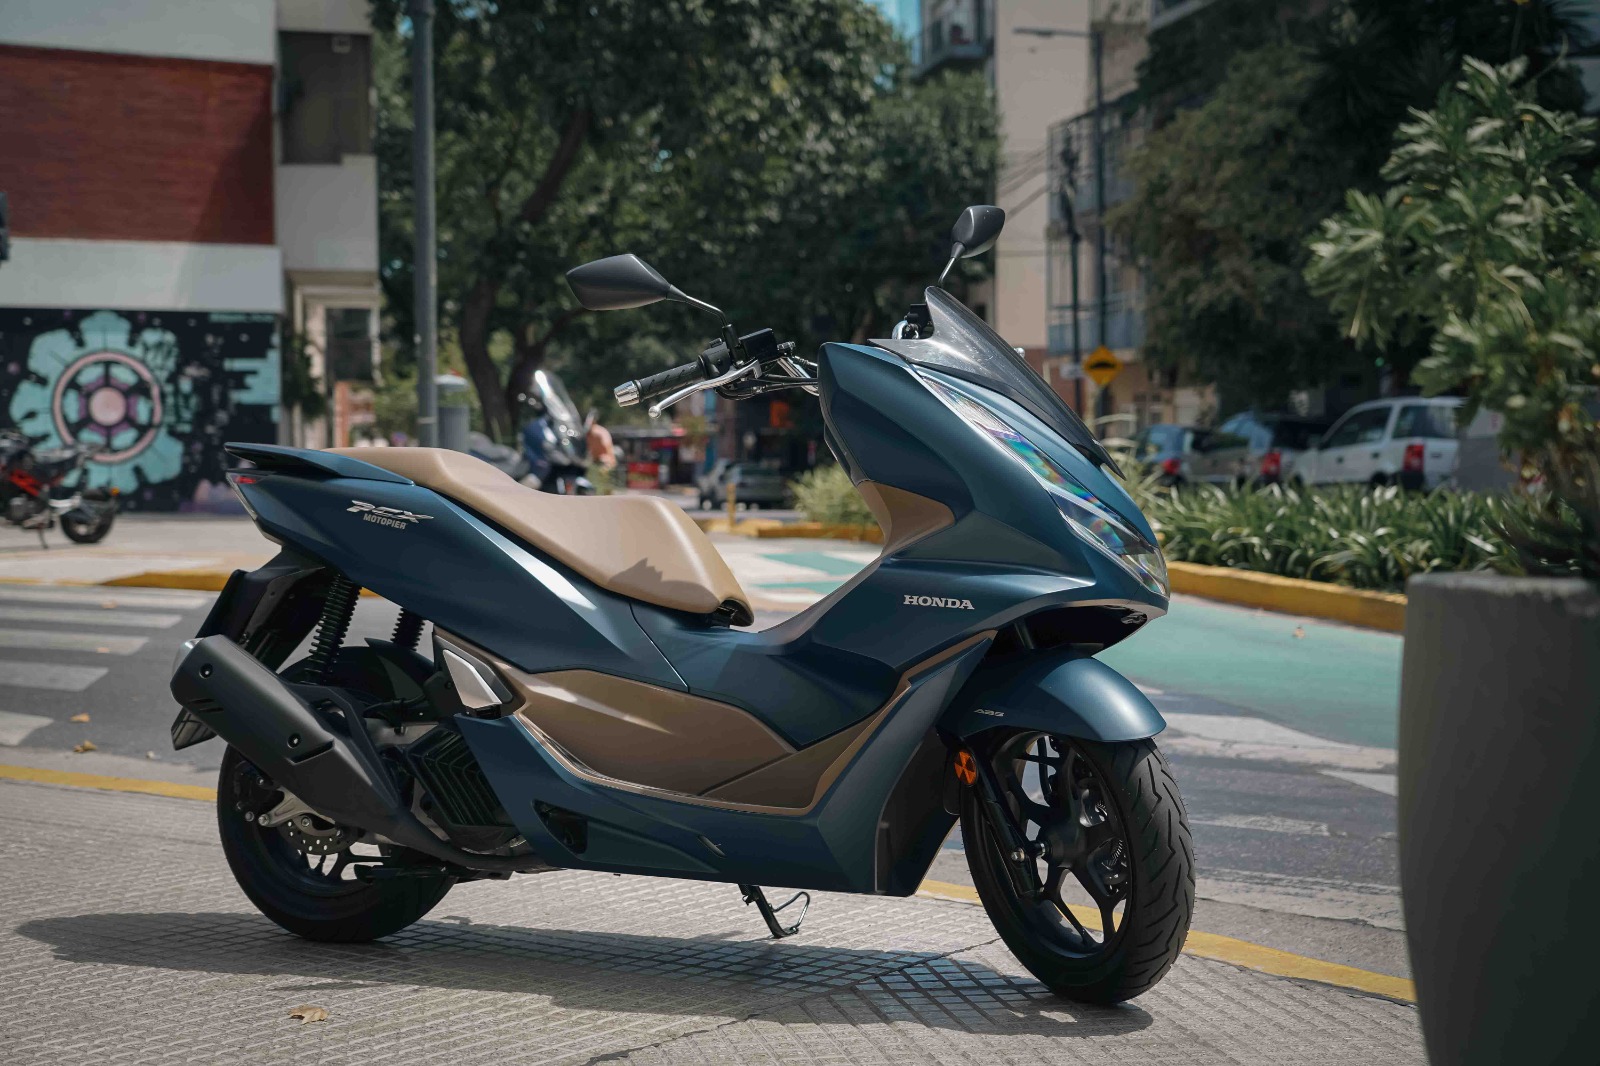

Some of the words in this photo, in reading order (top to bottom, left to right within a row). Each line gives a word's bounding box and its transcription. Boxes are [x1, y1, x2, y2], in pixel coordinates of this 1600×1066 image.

[346, 500, 434, 523] PCX
[363, 513, 407, 530] MOTOPIER
[903, 595, 975, 610] HONDA
[974, 708, 1005, 717] ABS
